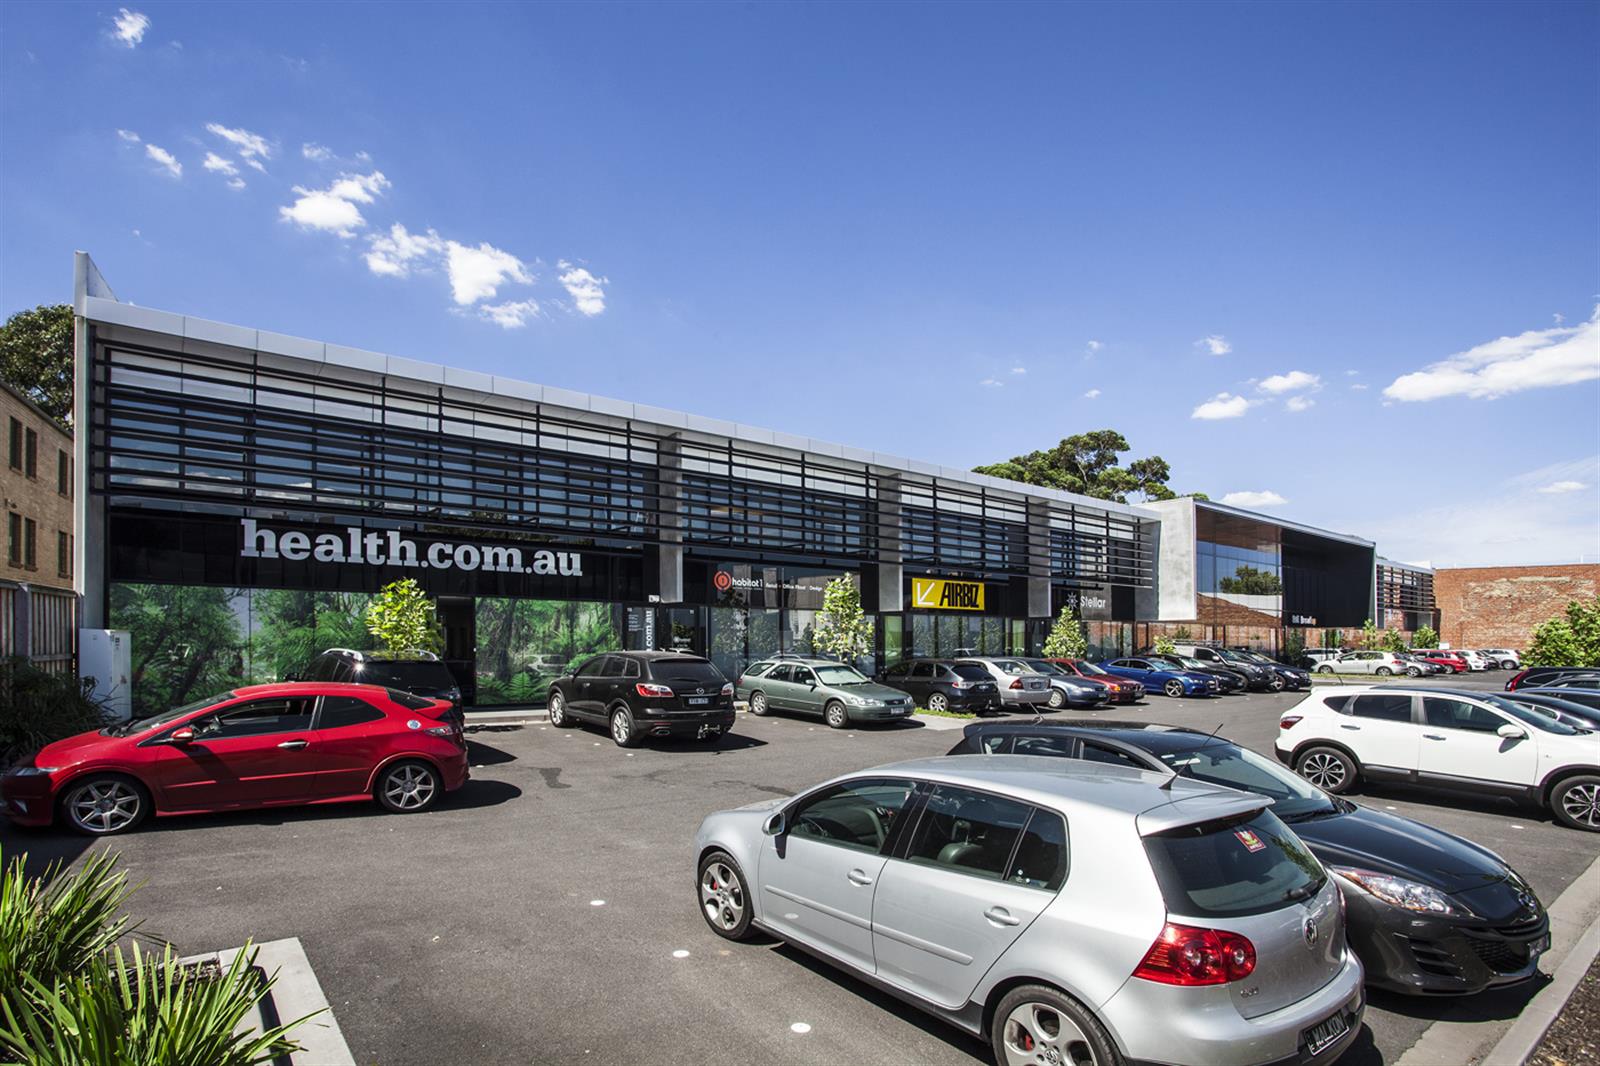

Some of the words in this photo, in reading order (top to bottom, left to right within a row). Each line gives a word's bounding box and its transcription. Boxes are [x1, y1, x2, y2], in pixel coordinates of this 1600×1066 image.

[240, 518, 583, 577] health.com.au
[939, 582, 979, 608] AIRBIZ
[1080, 596, 1106, 608] Stellar
